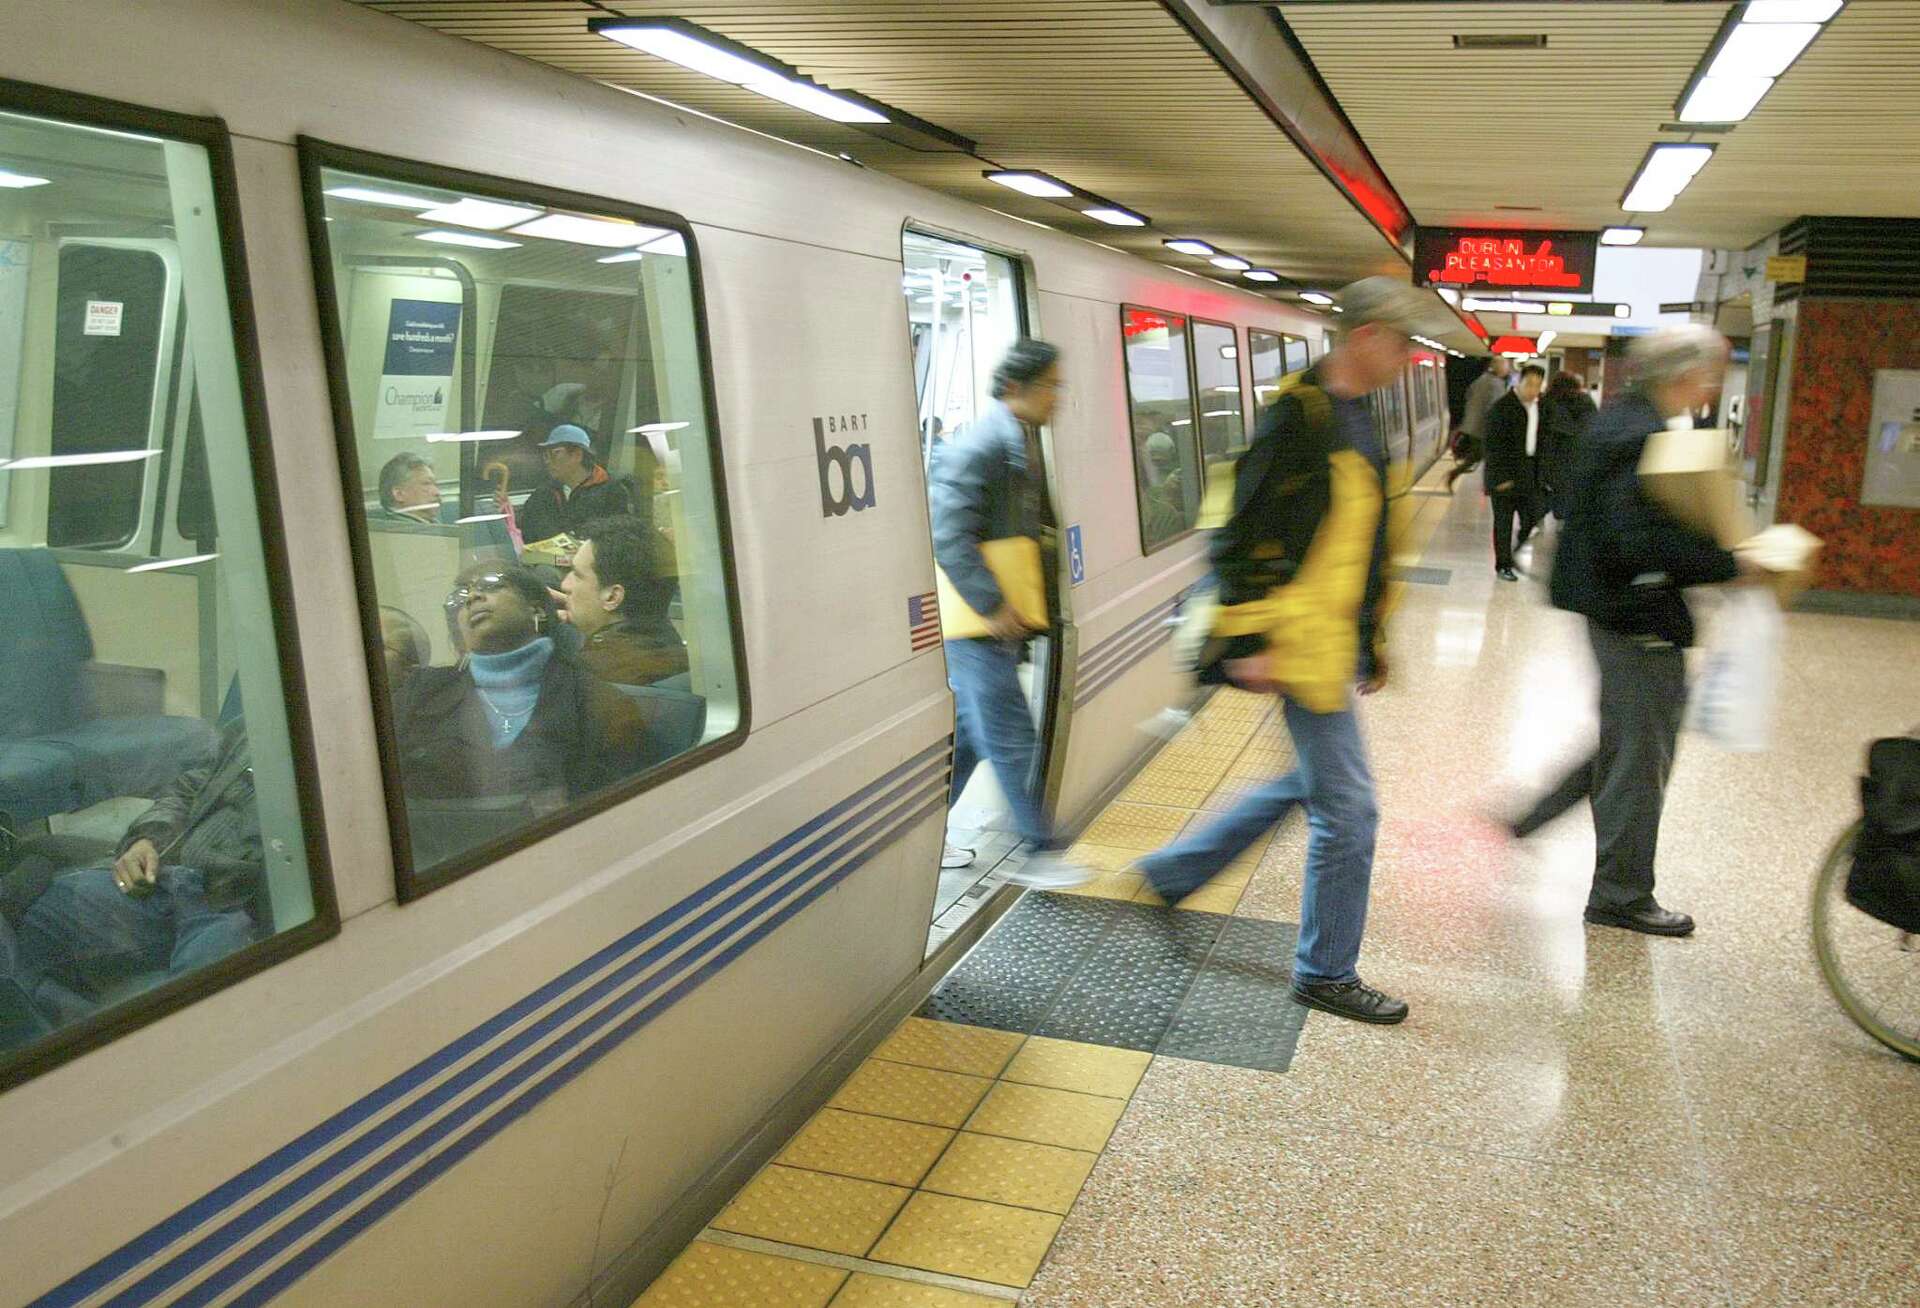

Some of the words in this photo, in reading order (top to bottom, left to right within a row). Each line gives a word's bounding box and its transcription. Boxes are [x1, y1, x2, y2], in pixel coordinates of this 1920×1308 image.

[1460, 239, 1522, 255] DUBLIN
[1447, 254, 1561, 272] PLEASANTON
[828, 414, 867, 433] BART
